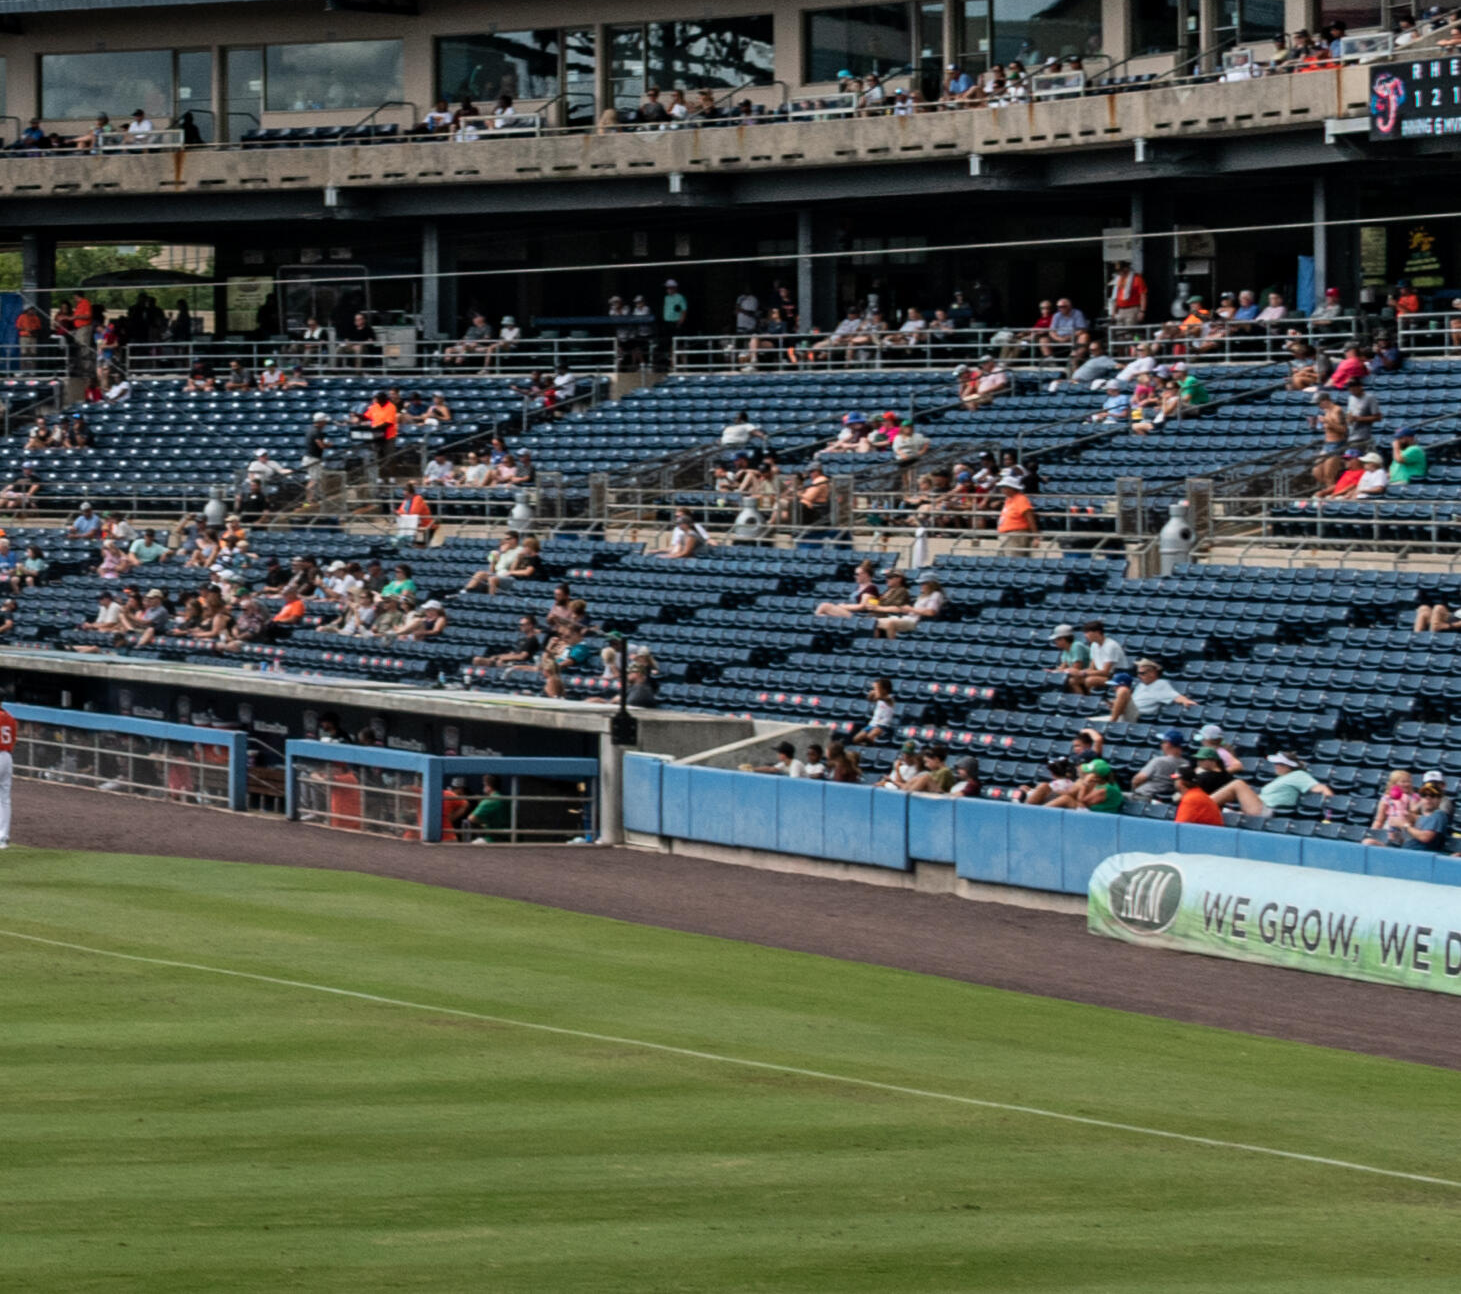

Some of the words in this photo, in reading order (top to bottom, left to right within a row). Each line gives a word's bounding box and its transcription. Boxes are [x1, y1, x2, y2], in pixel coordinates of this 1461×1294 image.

[1414, 90, 1421, 108] 1
[1431, 88, 1442, 106] 2
[1119, 869, 1176, 924] ALM
[1202, 890, 1251, 940] WE
[1258, 902, 1359, 964] GROW,
[1379, 920, 1434, 973] WE
